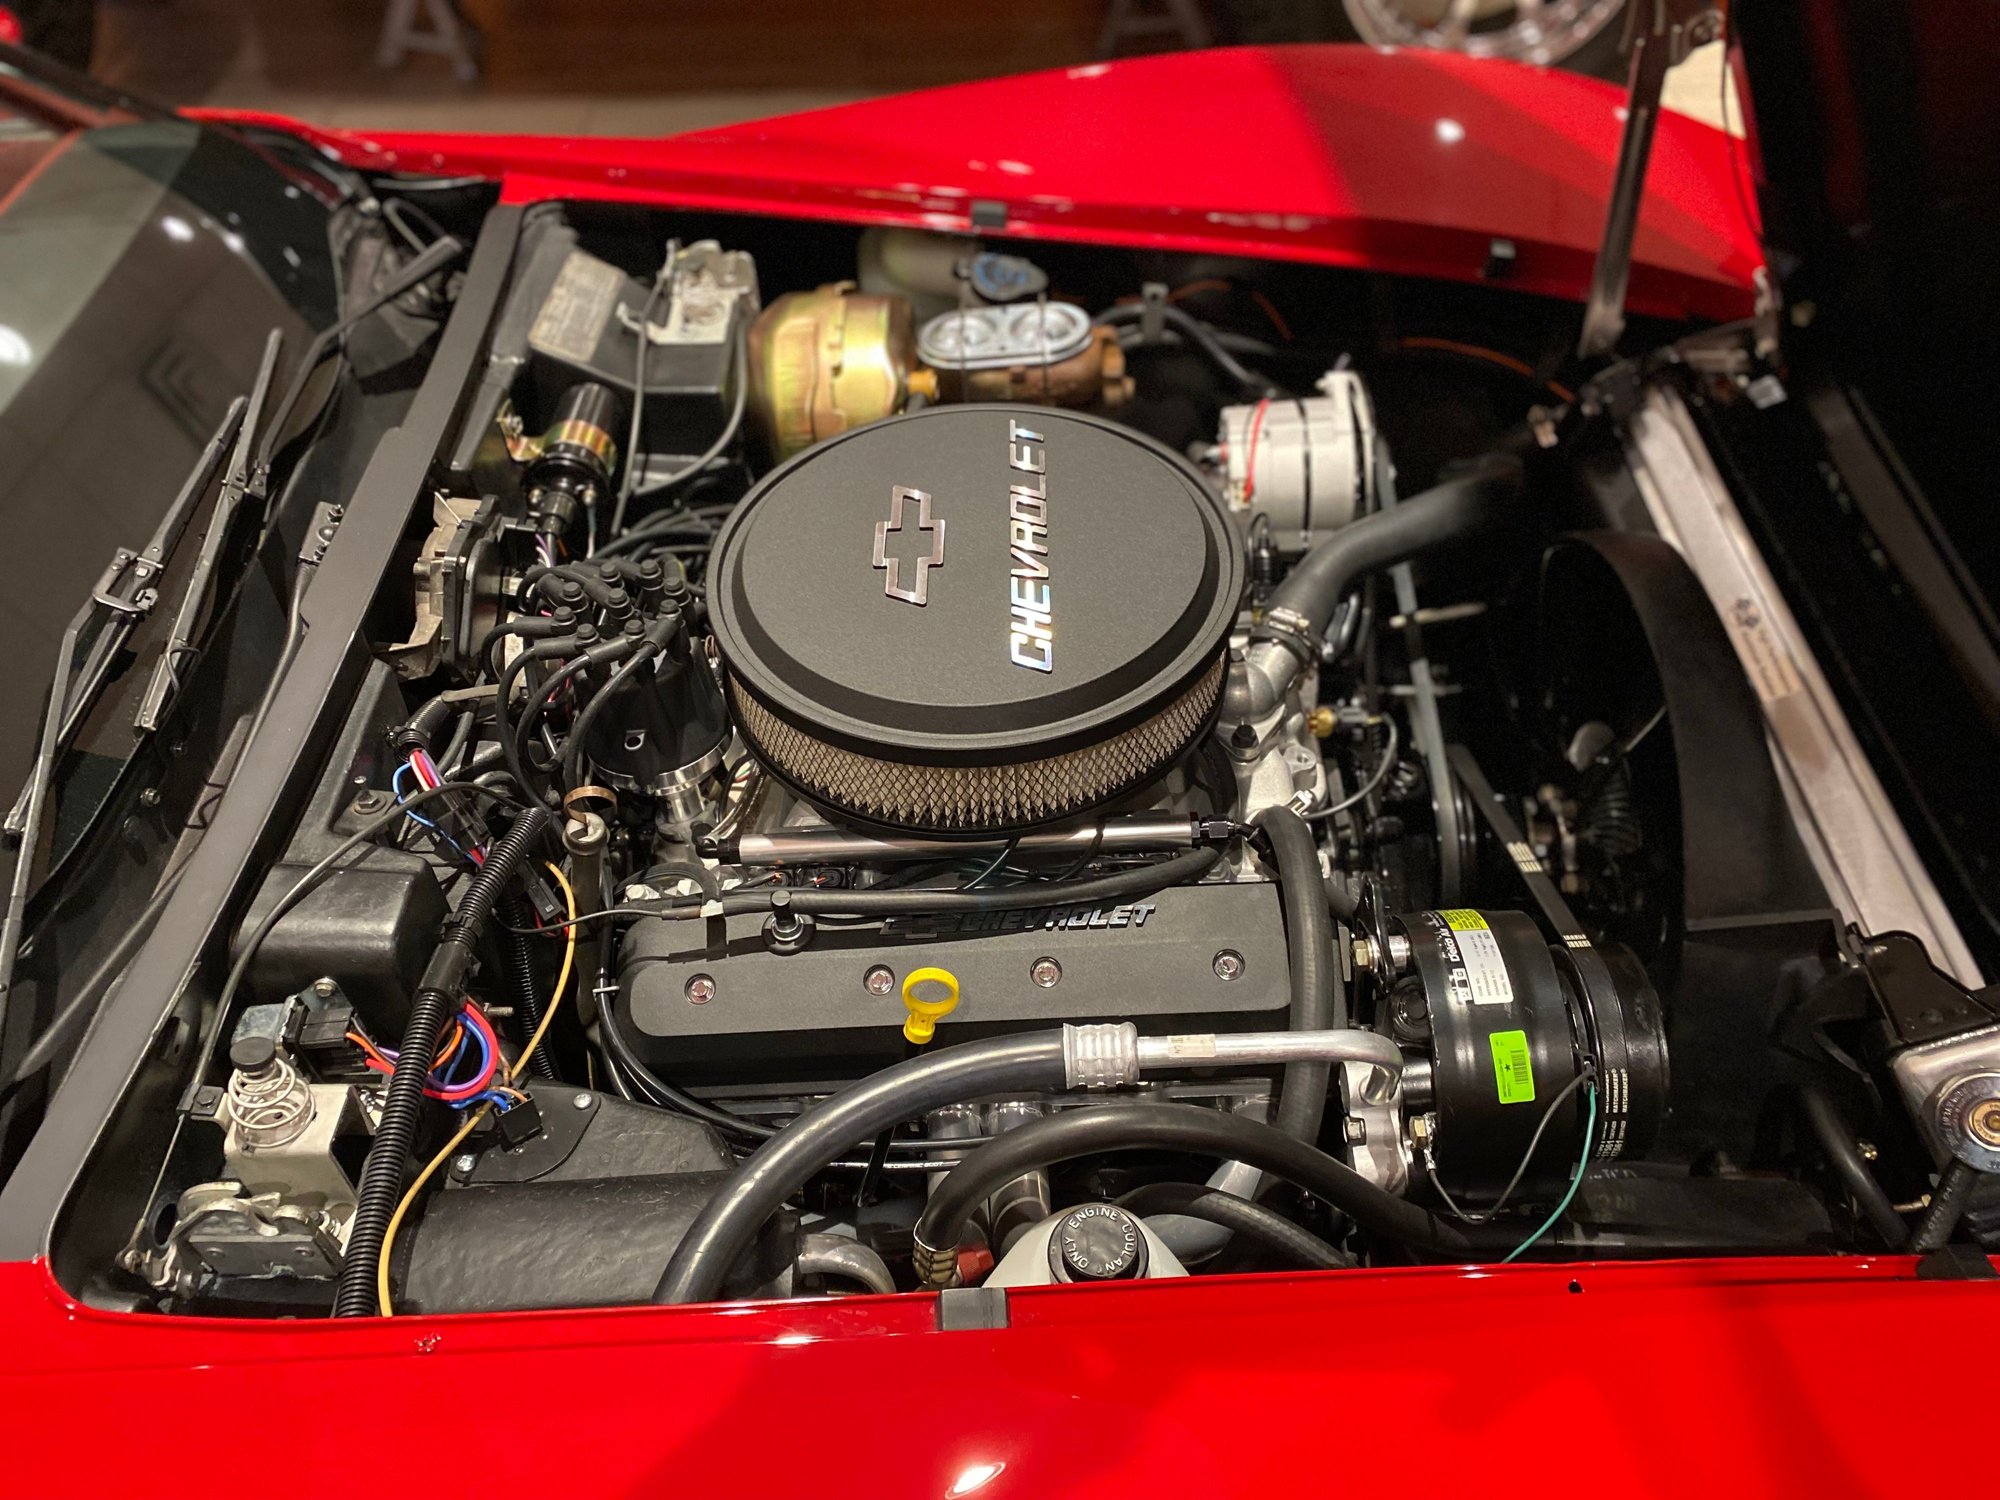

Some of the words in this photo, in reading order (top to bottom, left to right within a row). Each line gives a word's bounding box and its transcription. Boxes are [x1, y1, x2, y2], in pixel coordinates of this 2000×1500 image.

[1010, 419, 1052, 673] CHEVROLET
[962, 903, 1156, 932] CHEVROLET
[1445, 938, 1461, 962] Delco
[1068, 1207, 1120, 1229] ENGINE
[1064, 1236, 1089, 1269] ONLY
